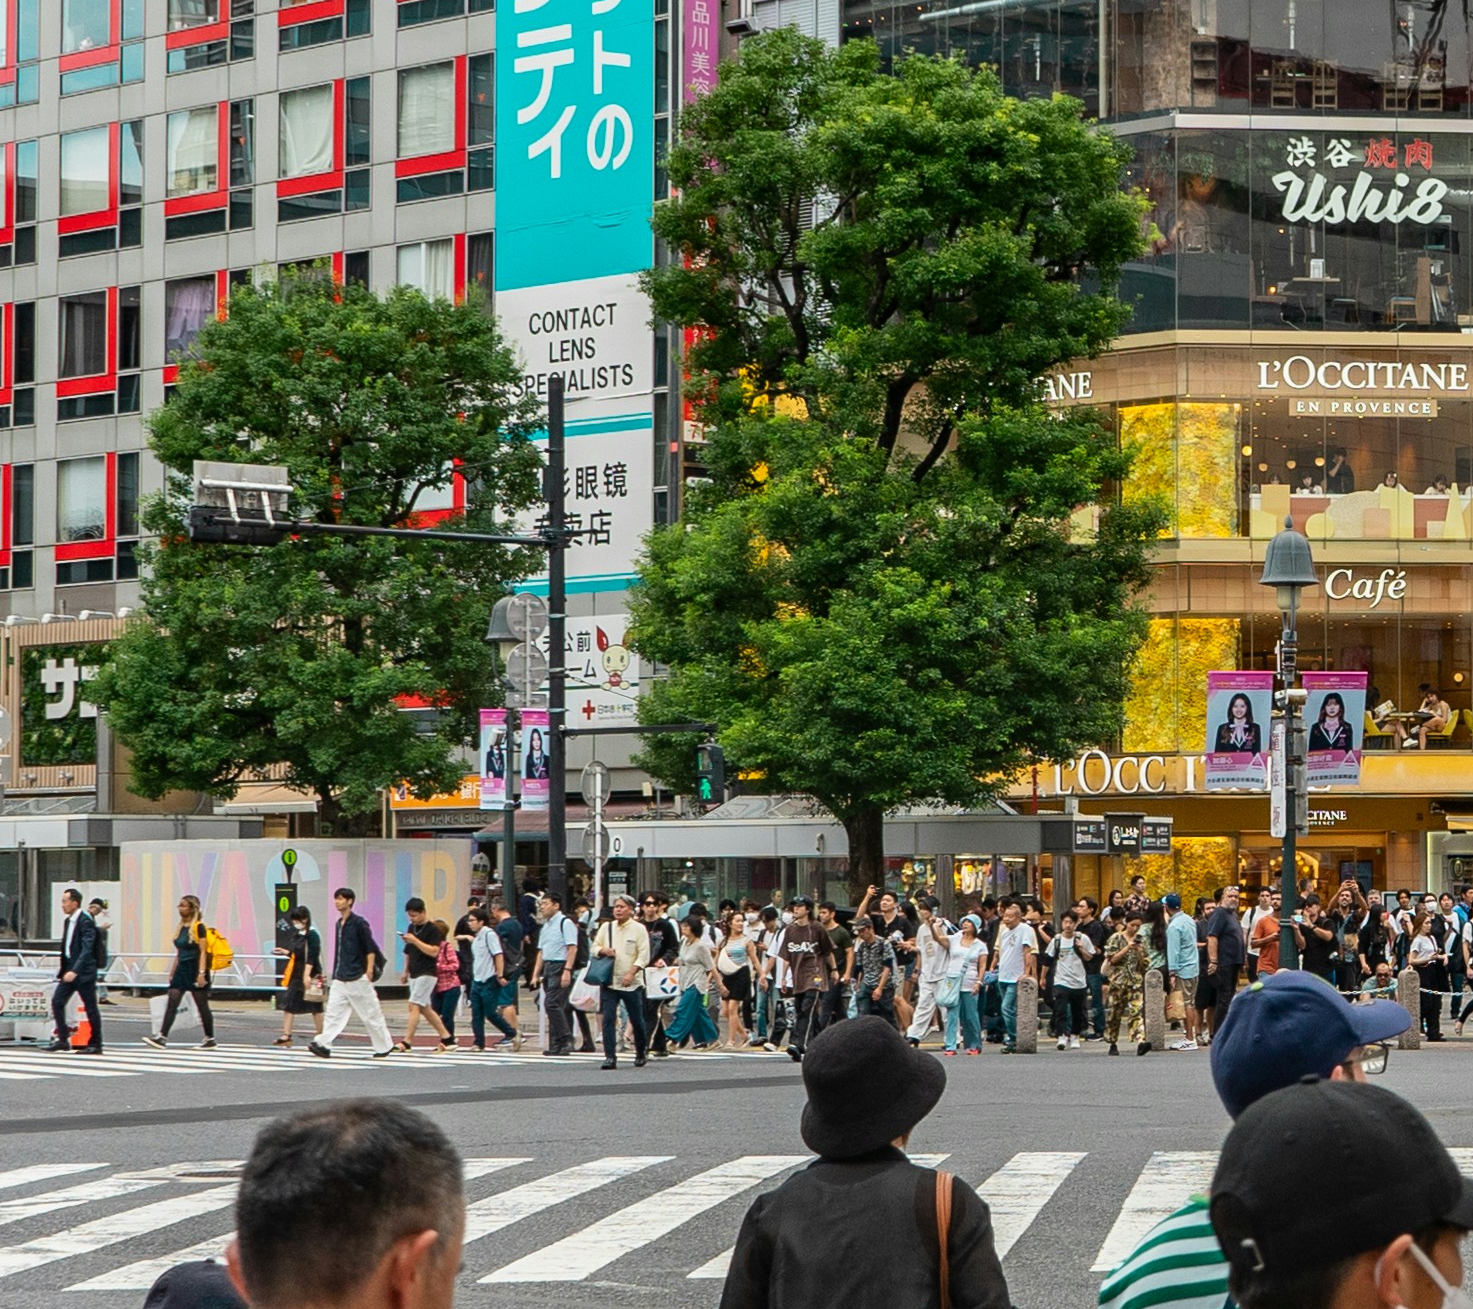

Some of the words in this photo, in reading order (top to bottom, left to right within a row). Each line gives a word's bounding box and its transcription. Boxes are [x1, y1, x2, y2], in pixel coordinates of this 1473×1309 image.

[1287, 136, 1435, 171] 渋谷焼肉
[1271, 171, 1447, 226] Ushi8
[528, 303, 618, 335] CONTACT
[549, 337, 596, 365] LENS
[1257, 355, 1470, 391] L'OCCITANE
[1296, 400, 1322, 415] EN
[1330, 399, 1432, 417] PROVENCE
[1326, 568, 1407, 609] Café
